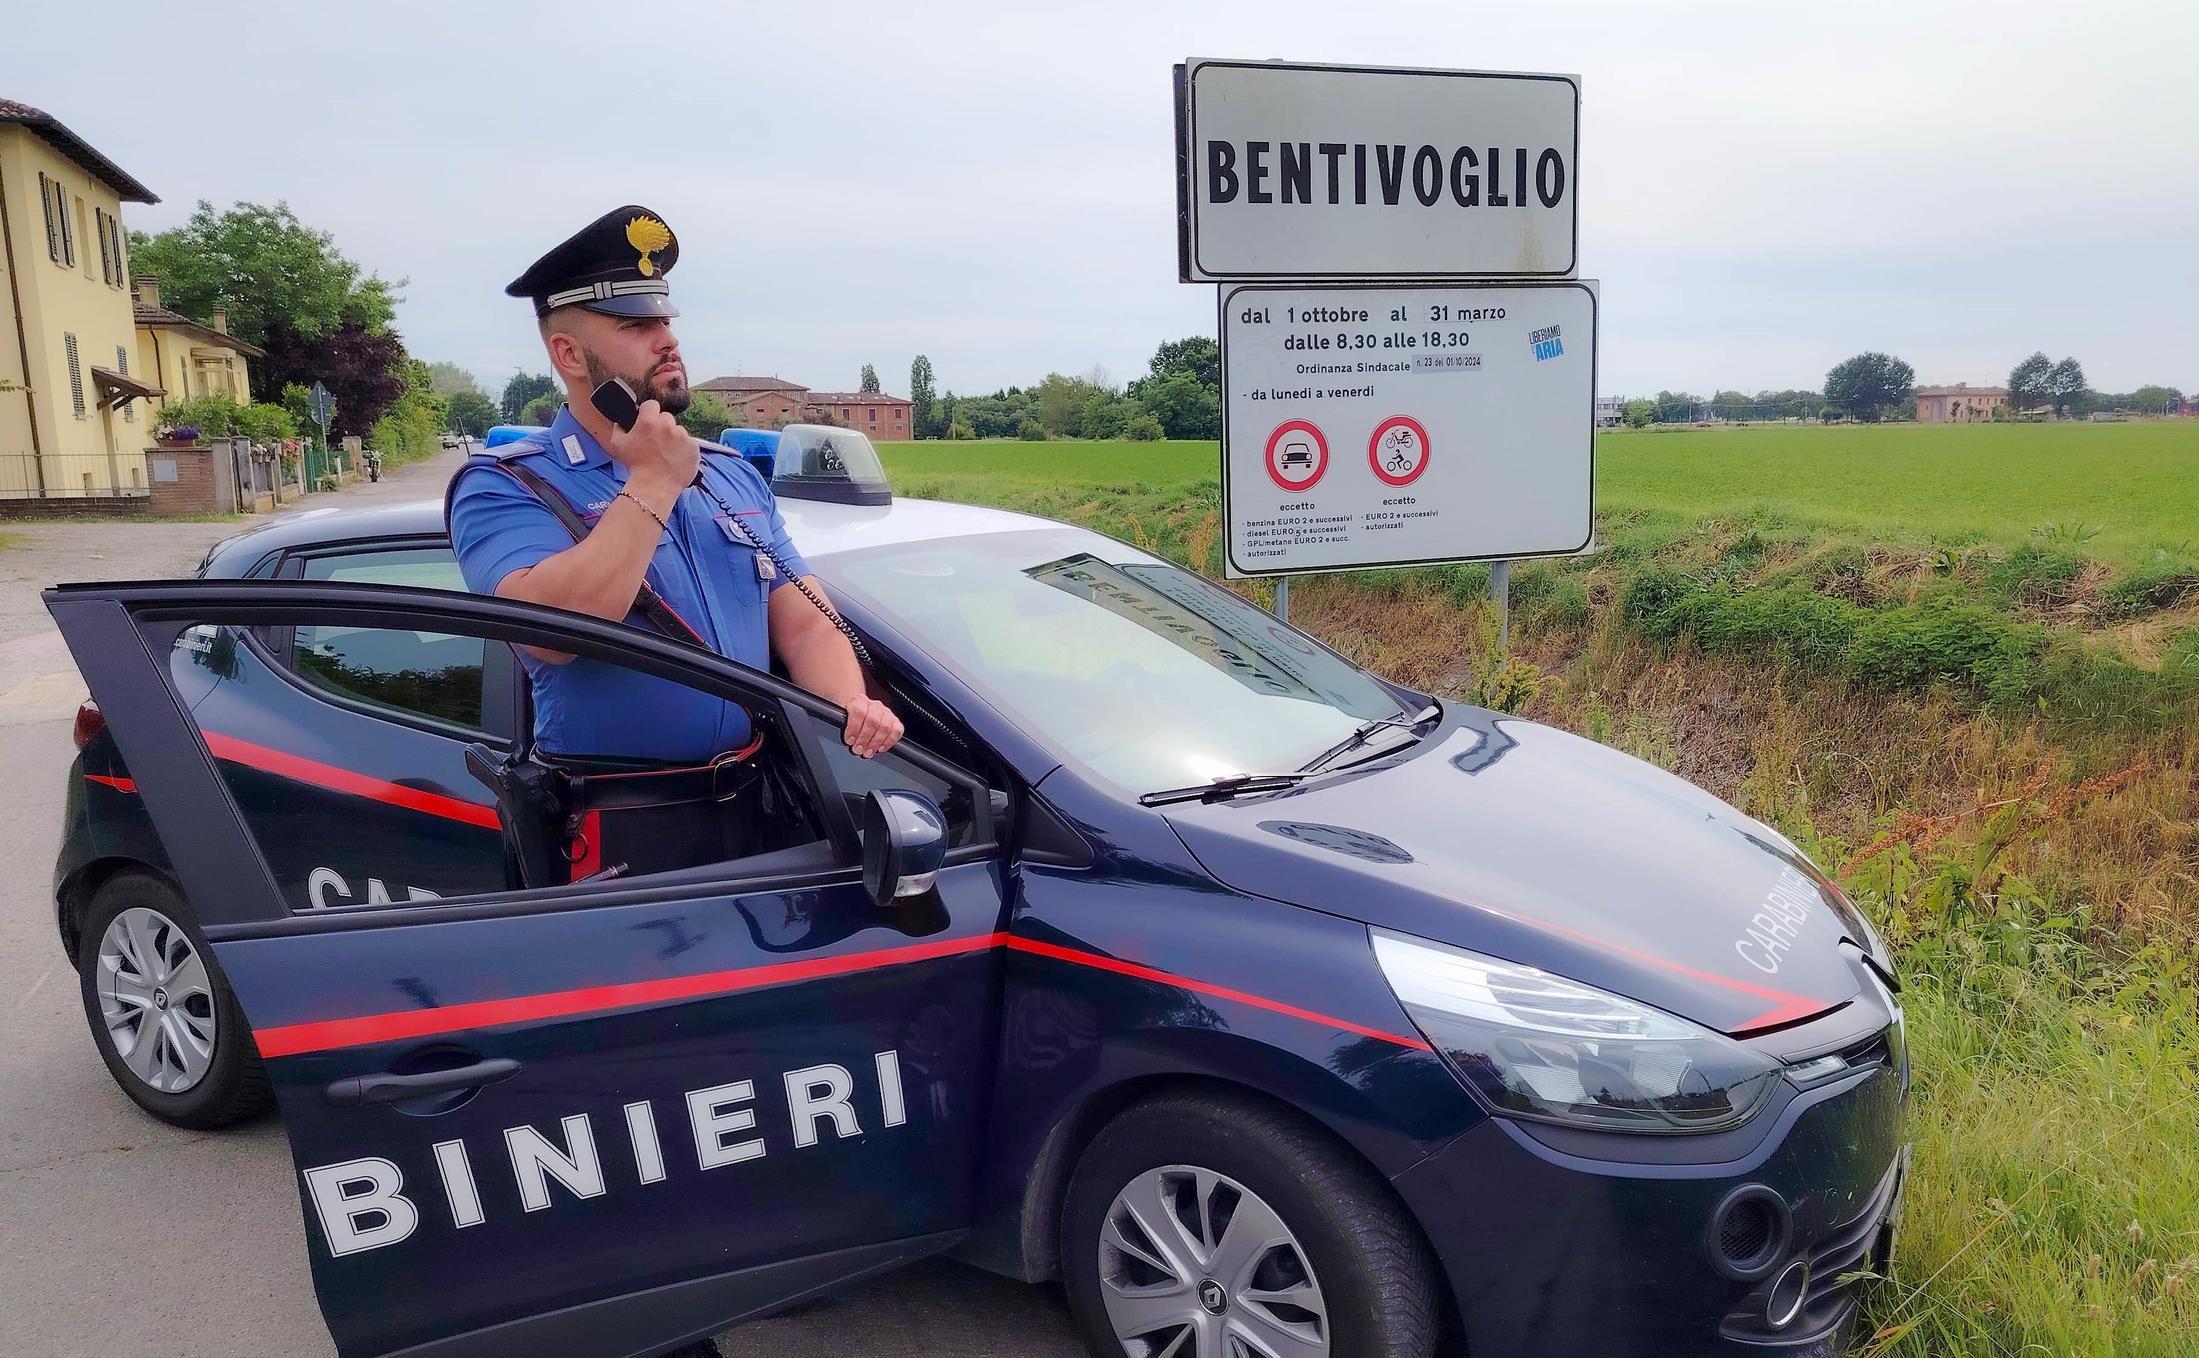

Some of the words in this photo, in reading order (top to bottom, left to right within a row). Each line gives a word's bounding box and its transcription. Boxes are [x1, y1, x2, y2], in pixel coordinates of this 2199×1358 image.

[1207, 139, 1566, 209] BENTIVOGLIO
[1241, 307, 1271, 324] dal
[1288, 307, 1295, 323] 1
[1301, 306, 1369, 323] ottobre
[1390, 305, 1407, 321] al
[1430, 305, 1448, 321] 31
[1457, 307, 1506, 321] marzo
[1284, 333, 1330, 350] dalle
[1336, 333, 1377, 350] 8,30
[1383, 332, 1416, 348] alle
[1422, 331, 1469, 348] 18,30
[1296, 363, 1353, 374] Ordinanza
[1356, 361, 1411, 373] Sindacale
[1424, 357, 1432, 367] 23
[1251, 389, 1267, 400] da
[1271, 387, 1312, 400] lunedi
[1315, 389, 1323, 399] a
[1327, 386, 1374, 398] venerdi
[1279, 502, 1316, 511] eccetto
[1382, 496, 1416, 506] eccetto
[1246, 519, 1276, 527] benzina
[1277, 517, 1301, 526] EURO
[1315, 514, 1353, 524] successivi
[1365, 512, 1388, 521] EURO
[1402, 509, 1439, 519] successivi
[1246, 529, 1269, 537] diesel
[1271, 528, 1294, 536] EURO
[1295, 529, 1301, 537] 5
[1309, 525, 1346, 534] successivi
[1365, 521, 1404, 531] autorizzati
[1247, 538, 1292, 548] GPL/metano
[1294, 536, 1317, 545] EURO
[1247, 548, 1287, 558] autorizzati
[303, 1049, 907, 1259] BINIERI
